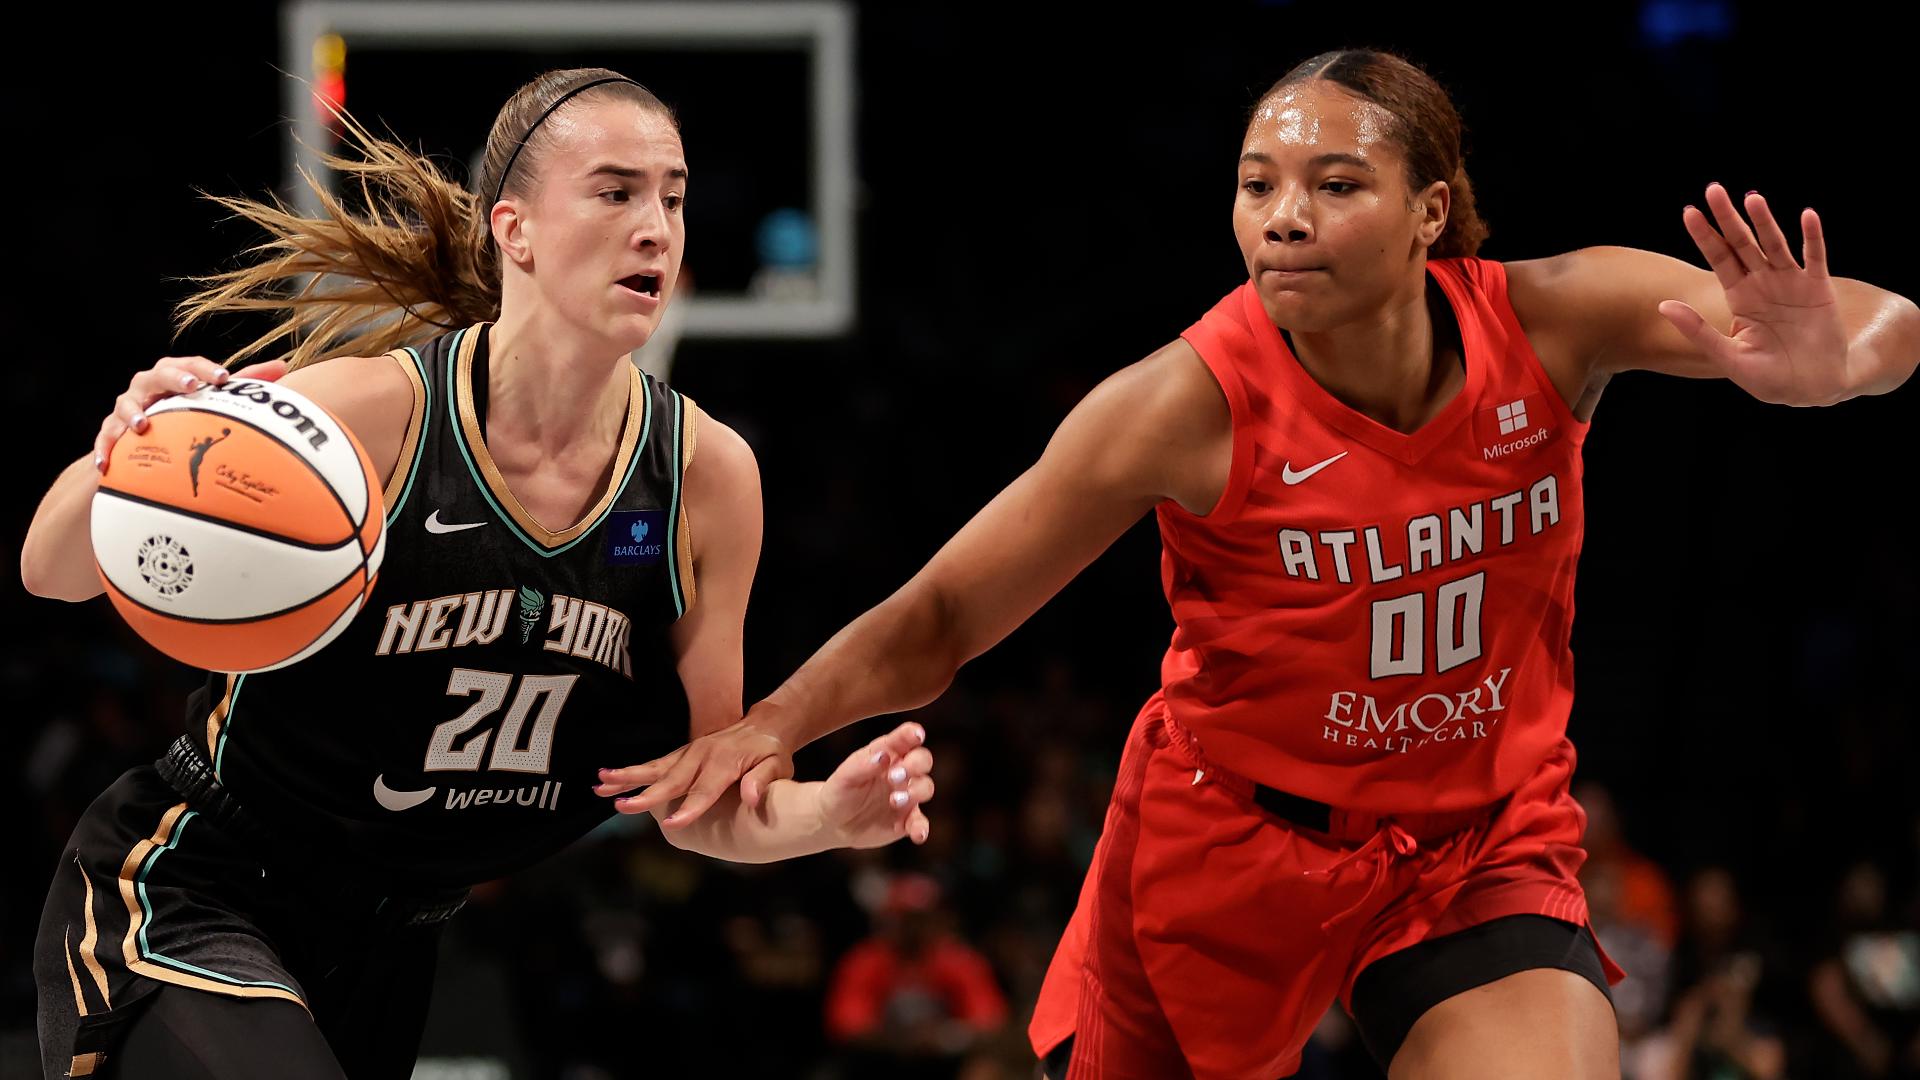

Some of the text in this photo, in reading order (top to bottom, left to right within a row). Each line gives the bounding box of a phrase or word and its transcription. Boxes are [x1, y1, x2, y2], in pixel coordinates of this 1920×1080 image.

[1484, 427, 1549, 460] Microsoft
[614, 545, 661, 556] BARCLAYS
[1278, 474, 1560, 583] ATLANTA
[375, 589, 635, 682] NEW YORK
[1370, 571, 1485, 680] 00
[423, 667, 581, 775] 20
[1322, 718, 1499, 754] HEALTCAR
[1323, 667, 1512, 735] EMORY
